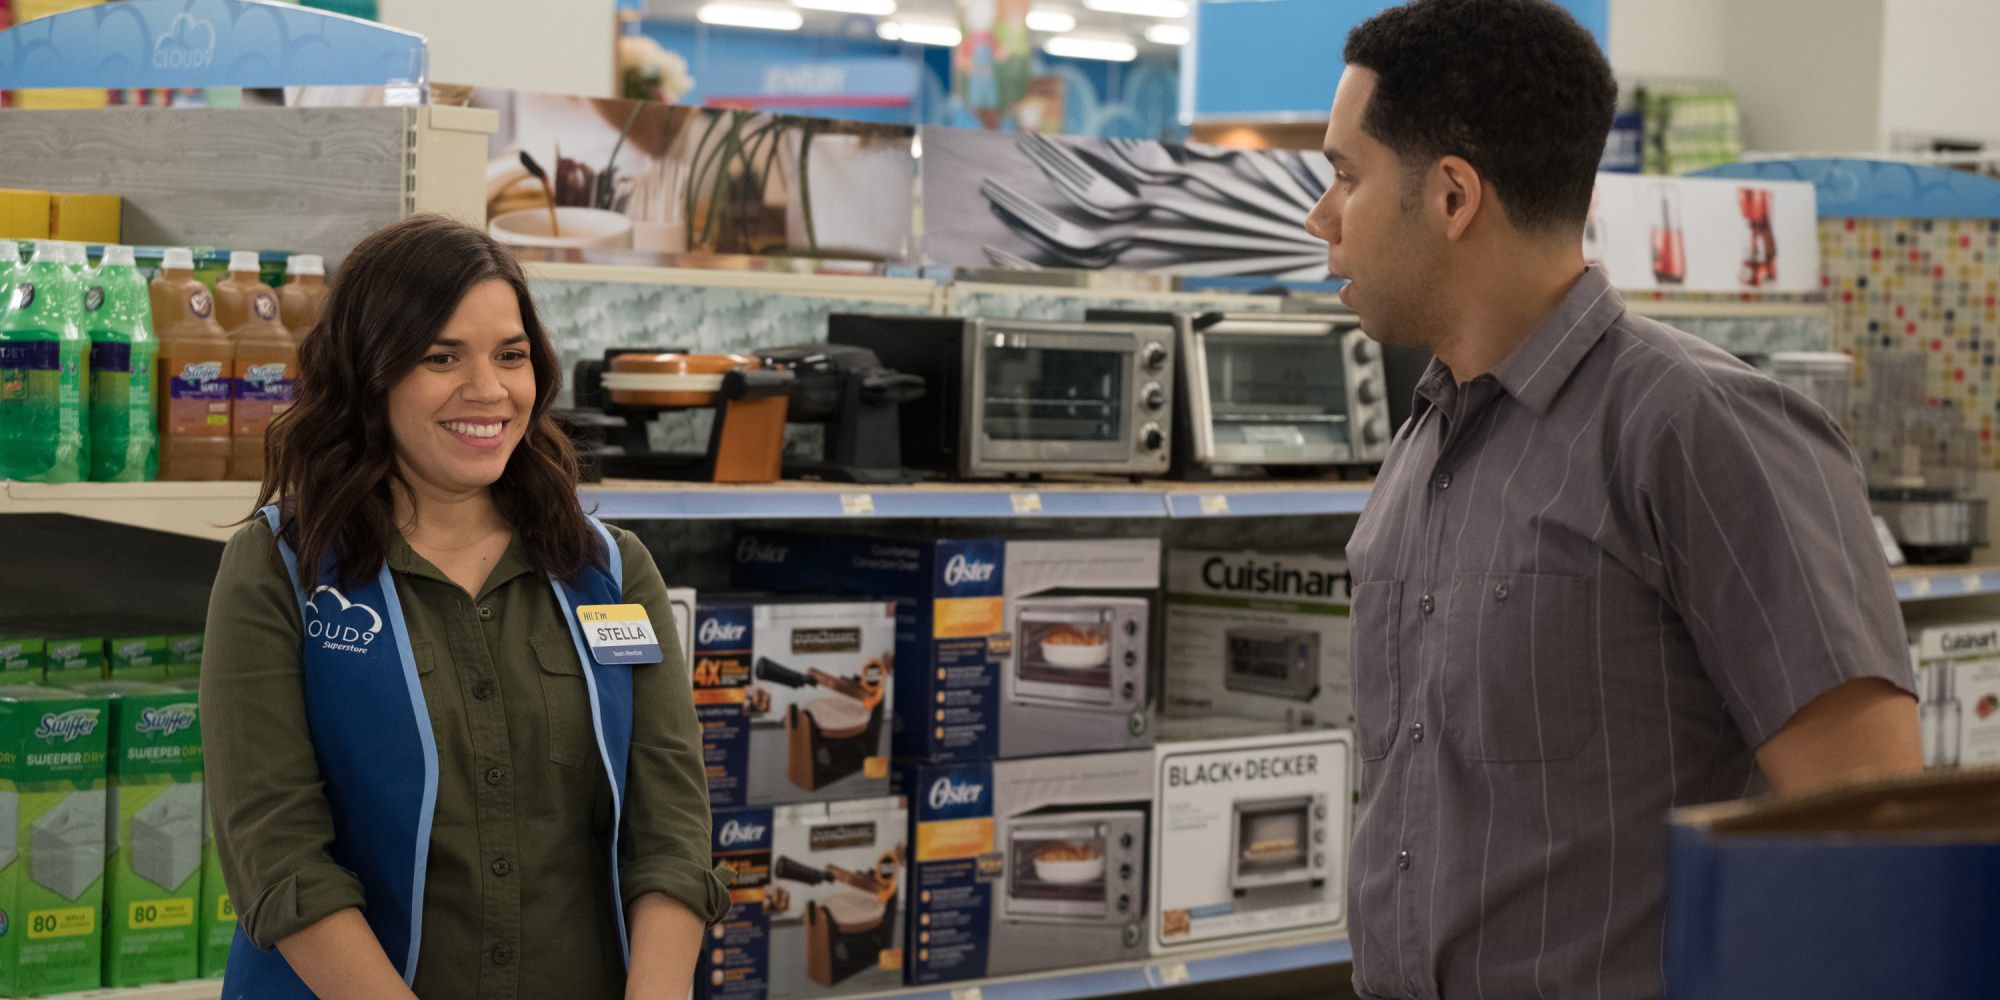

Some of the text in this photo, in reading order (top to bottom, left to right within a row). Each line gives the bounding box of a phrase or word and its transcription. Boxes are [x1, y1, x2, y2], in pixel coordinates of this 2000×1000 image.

[944, 553, 995, 587] Oster
[1202, 556, 1352, 598] Cuisinart
[583, 611, 607, 620] Hi! I'm
[308, 619, 375, 645] OUD9
[597, 627, 647, 642] STELLA
[699, 617, 746, 645] Oster
[322, 640, 368, 654] Superstore
[694, 657, 721, 686] 4X
[35, 712, 98, 742] Swiffer
[136, 707, 196, 736] Swiffer
[27, 751, 104, 766] SWEEPER DRY
[128, 746, 180, 759] SWEEPER
[1168, 754, 1318, 787] BLACK+DECKER
[930, 777, 983, 810] Oster
[719, 819, 766, 847] Oster
[33, 915, 57, 933] 80
[134, 905, 157, 924] 80
